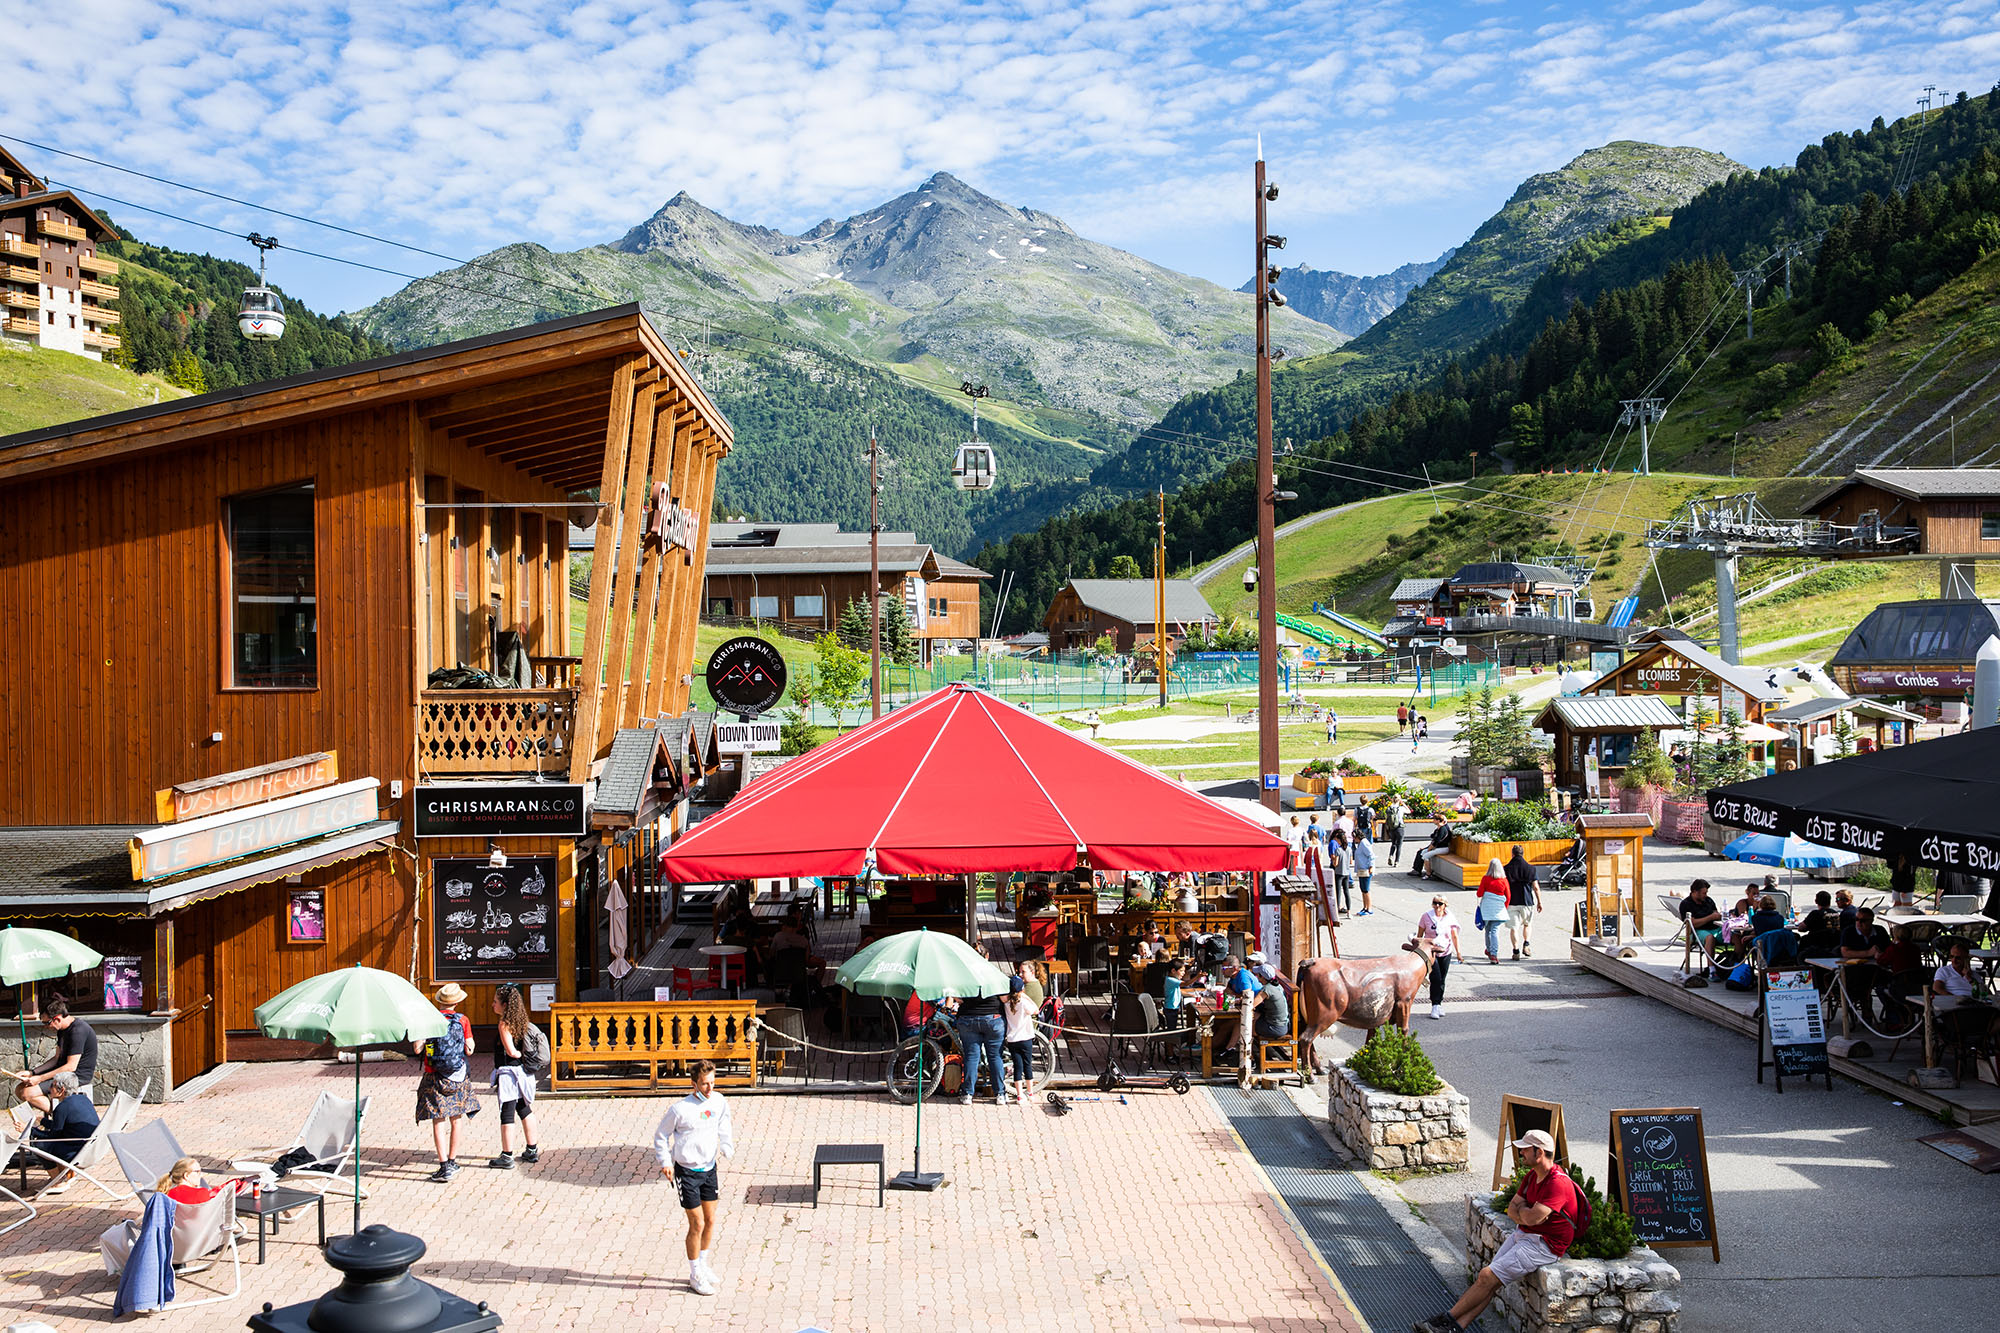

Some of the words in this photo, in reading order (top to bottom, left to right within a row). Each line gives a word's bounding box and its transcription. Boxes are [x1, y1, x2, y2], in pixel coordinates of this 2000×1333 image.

[1645, 669, 1681, 681] COMBES
[1894, 673, 1940, 687] Combes
[718, 726, 748, 742] DOWN
[751, 725, 779, 741] TOWN
[475, 814, 517, 822] MONTAGNE
[526, 813, 574, 821] RESTAURANT
[1713, 797, 1741, 819] CÔTE
[1743, 803, 1778, 829] BRUNE
[1806, 815, 1836, 841] CÔTE
[1840, 822, 1885, 850] BRUNE
[152, 838, 190, 872] LE
[1920, 835, 1960, 864] CÔTE
[1965, 842, 2000, 871] BRU
[1273, 913, 1281, 956] GRENIER
[1674, 1114, 1695, 1122] SPORT
[1651, 1158, 1686, 1170] Concert
[1629, 1170, 1654, 1182] LARGE
[1672, 1180, 1697, 1191] JEUX
[1641, 1216, 1661, 1227] Live
[1665, 1225, 1689, 1234] Music
